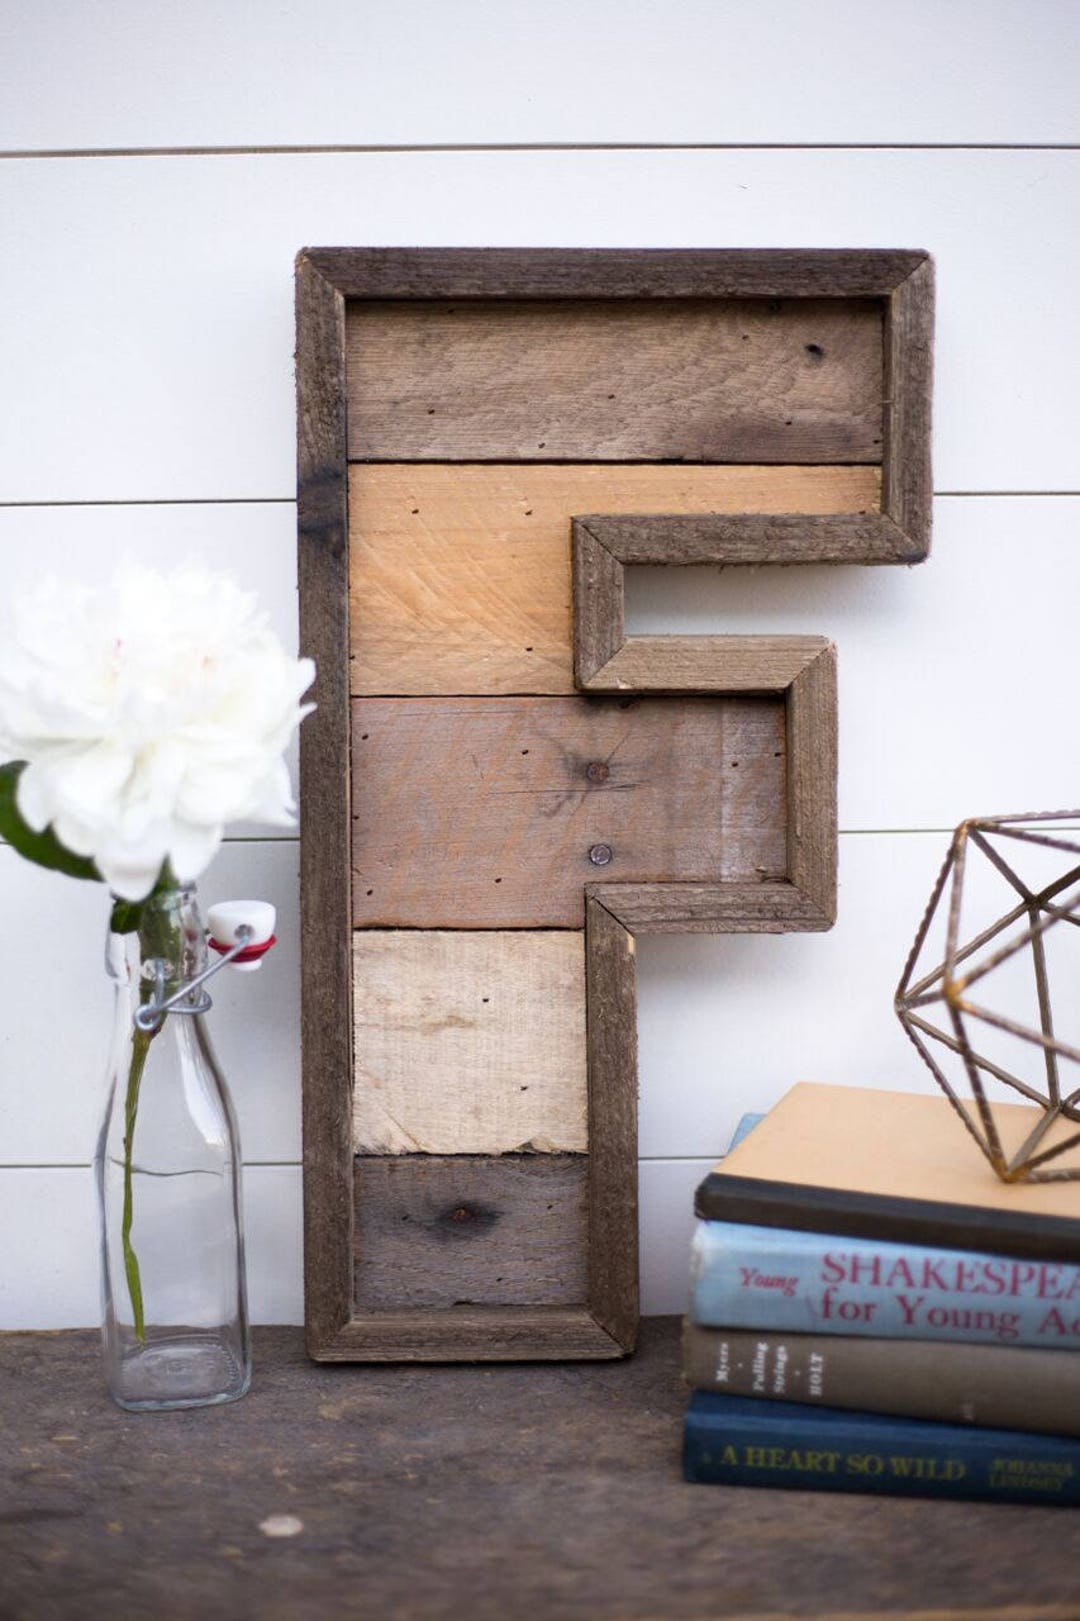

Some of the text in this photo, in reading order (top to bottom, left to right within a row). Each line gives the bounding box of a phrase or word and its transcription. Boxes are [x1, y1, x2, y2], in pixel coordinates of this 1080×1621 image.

[739, 1267, 799, 1297] Young
[820, 1286, 877, 1323] for
[894, 1294, 1021, 1338] Young
[715, 1342, 730, 1383] Myers
[809, 1352, 823, 1397] HOLT
[720, 1444, 967, 1482] A HEART SO WILD
